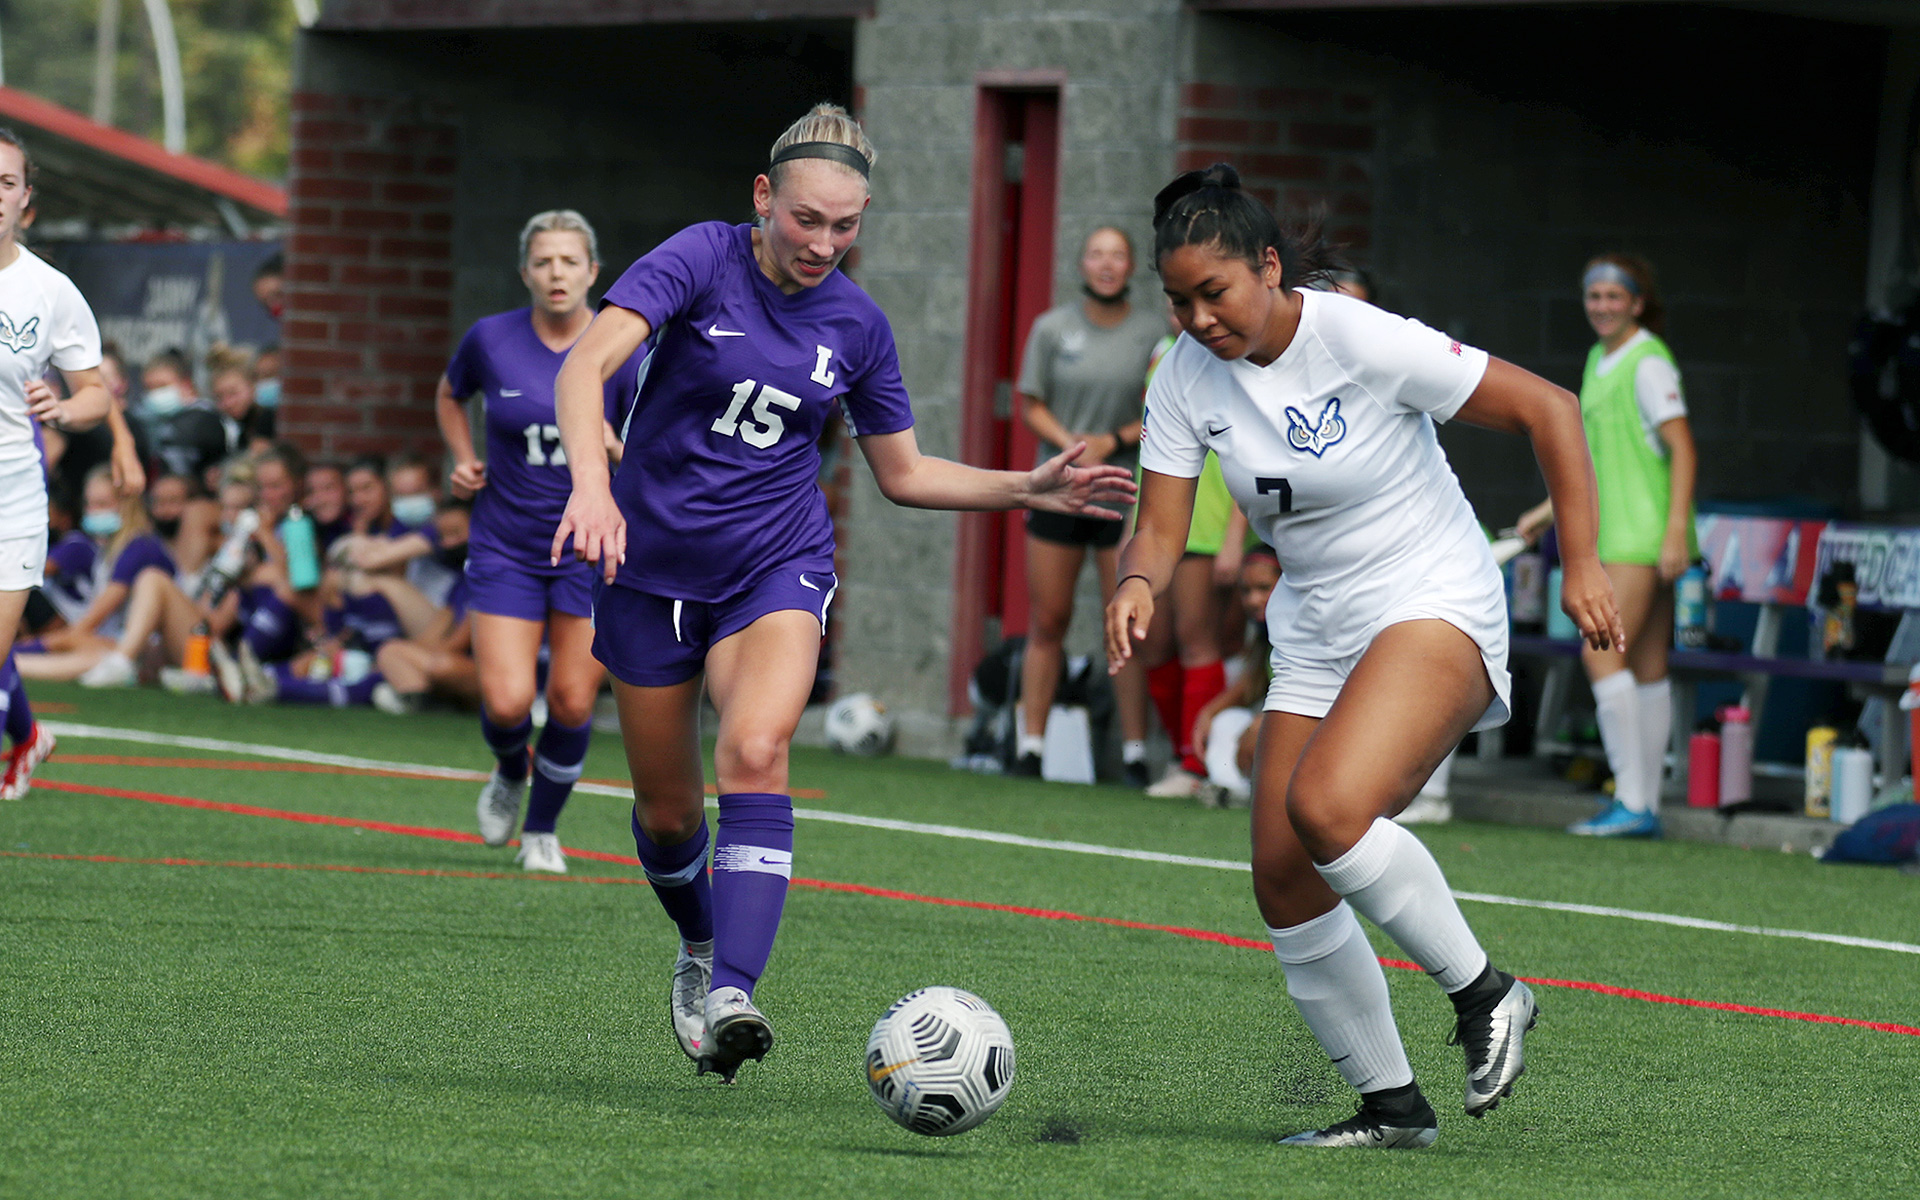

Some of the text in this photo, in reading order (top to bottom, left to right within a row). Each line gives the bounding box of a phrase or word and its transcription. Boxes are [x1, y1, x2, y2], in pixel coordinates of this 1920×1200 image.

[810, 344, 835, 388] L
[711, 378, 801, 449] 15
[1255, 476, 1292, 513] 7
